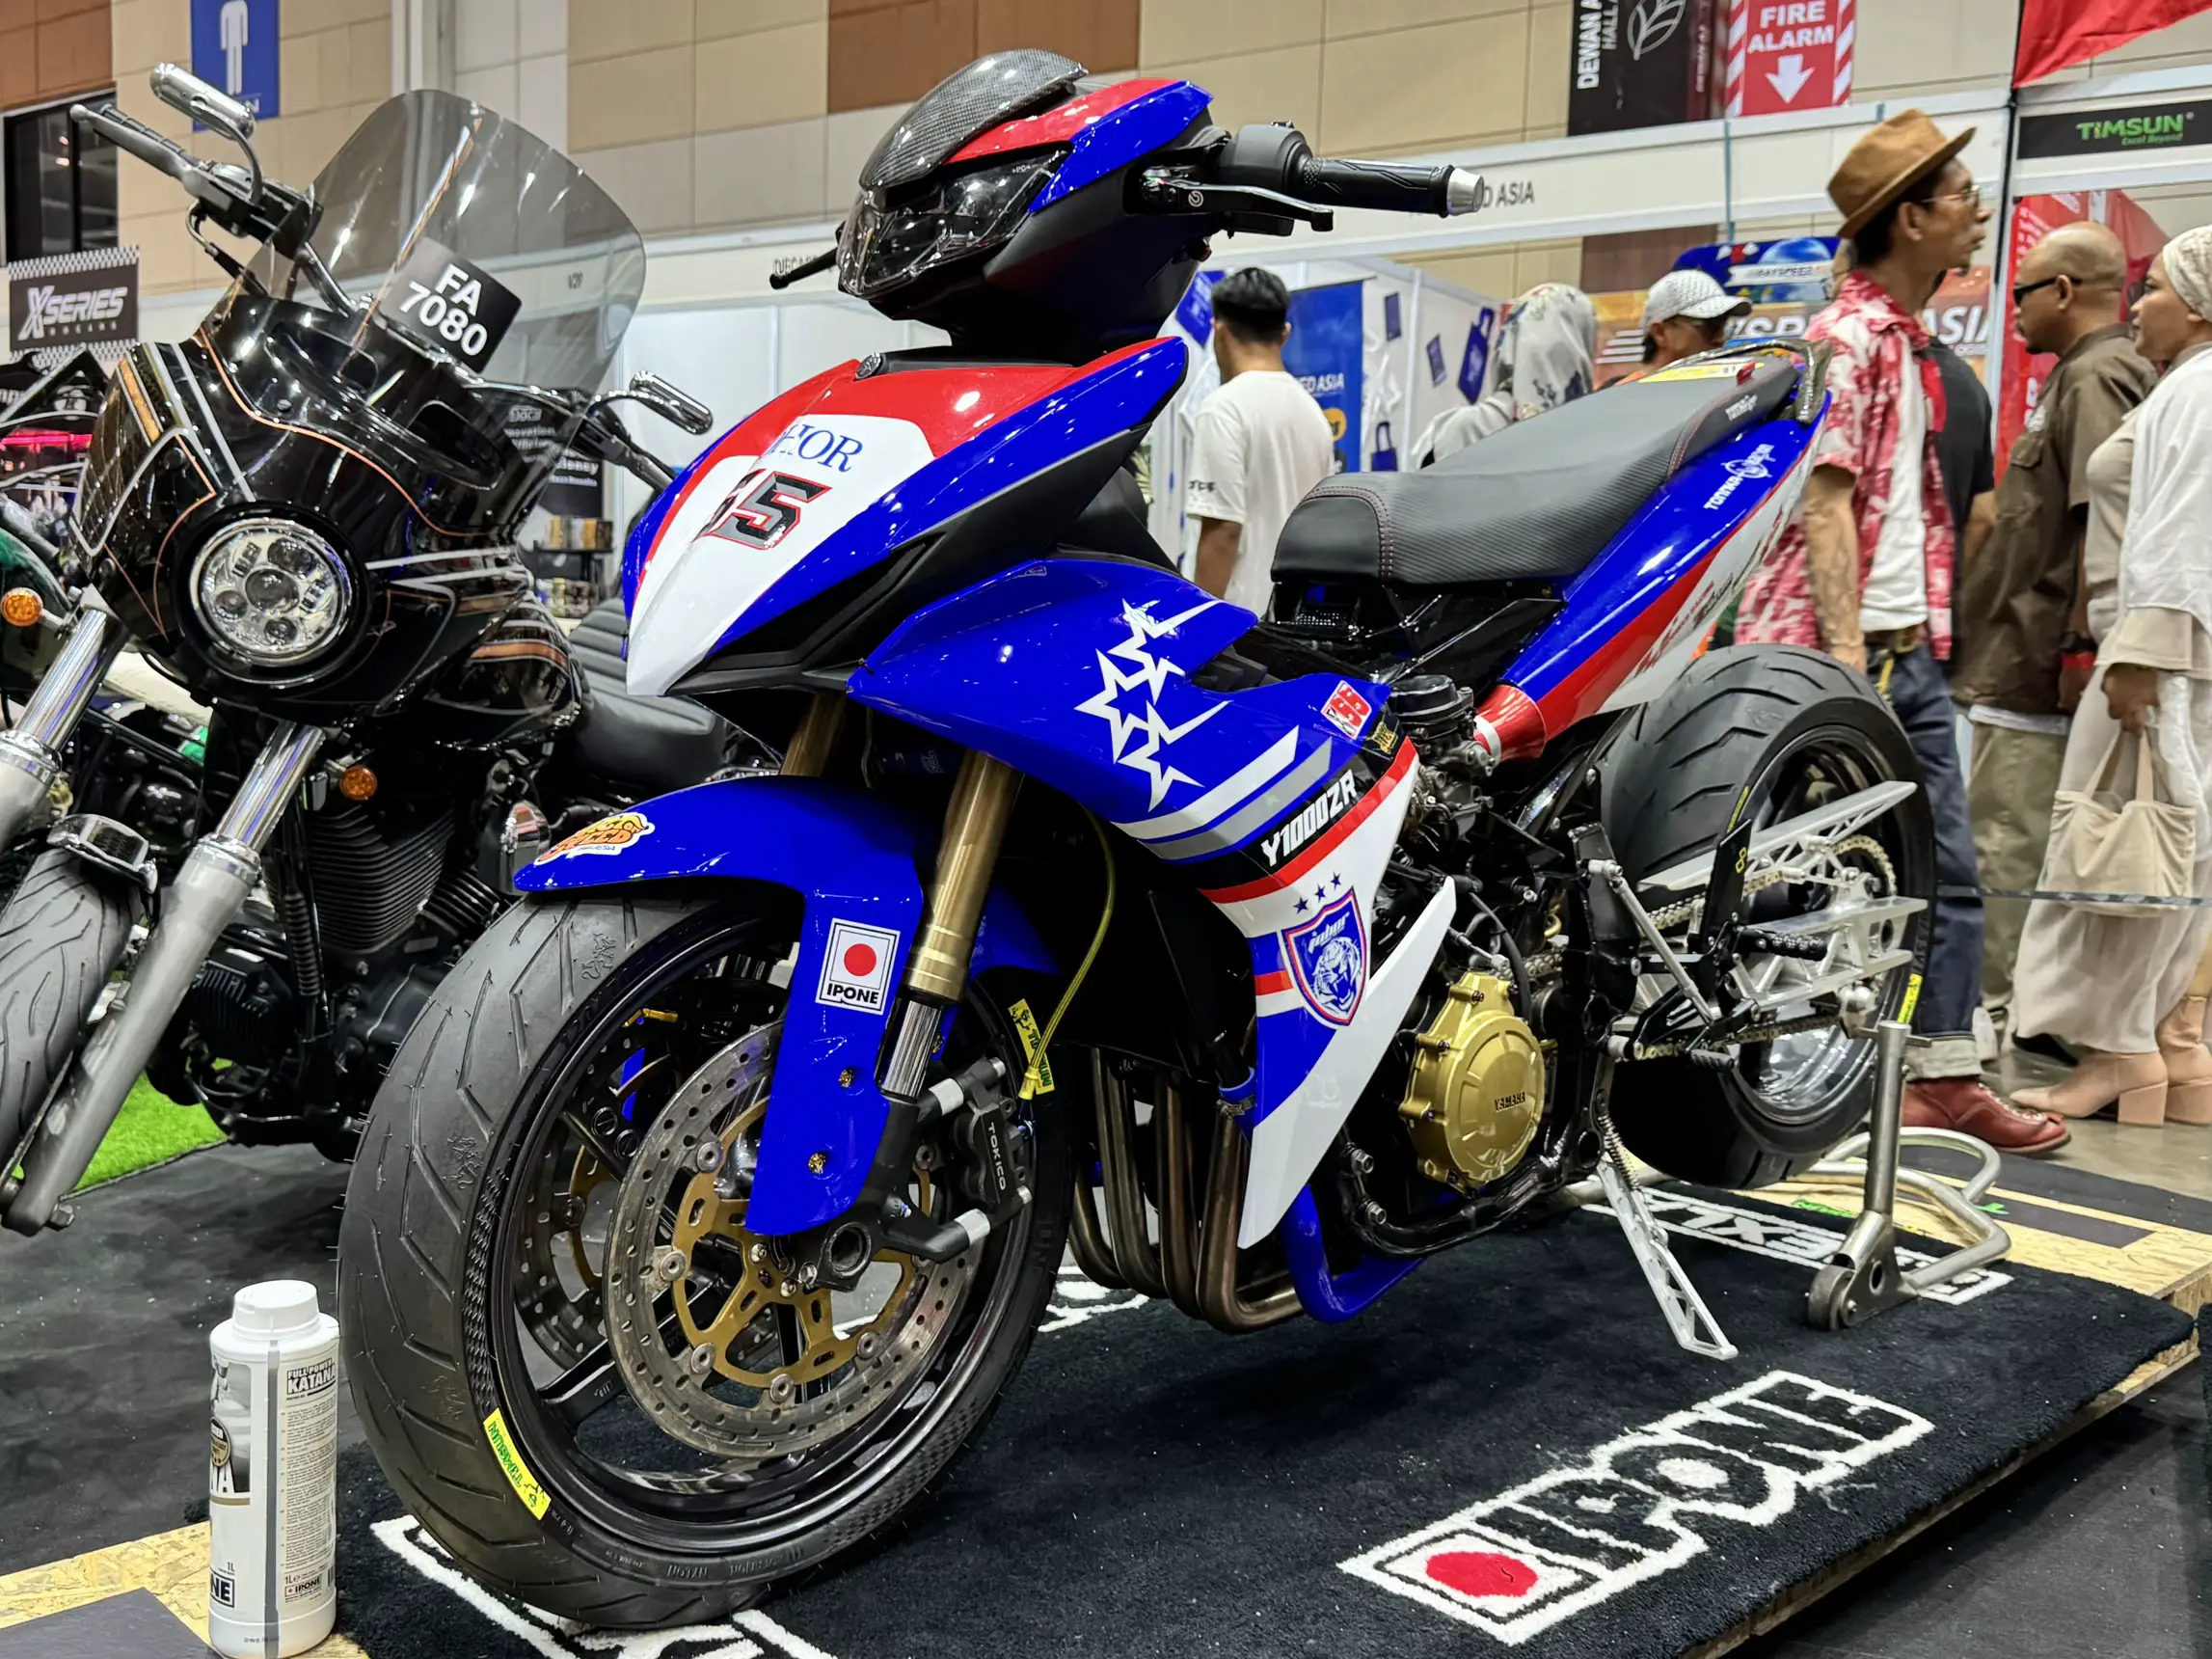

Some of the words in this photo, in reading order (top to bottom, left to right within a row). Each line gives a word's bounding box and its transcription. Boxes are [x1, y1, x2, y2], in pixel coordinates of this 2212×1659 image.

[1601, 5, 1619, 50] HALL
[1748, 24, 1834, 53] ALARM
[1760, 1, 1825, 28] FIRE
[1577, 12, 1602, 90] DEWAN
[2076, 114, 2184, 141] TIMSUN
[1496, 181, 1535, 208] ASIA
[17, 285, 128, 341] XSERIES
[435, 263, 482, 317] FA
[400, 281, 488, 357] 7080
[1316, 372, 1344, 393] ASIA
[1260, 769, 1358, 867] Y1000ZR
[826, 983, 879, 1005] IPONE
[1027, 1028, 1052, 1087] TIUN
[987, 1122, 1007, 1191] TOKICO
[287, 1363, 336, 1394] KATANA
[488, 1420, 524, 1488] TIMSUN
